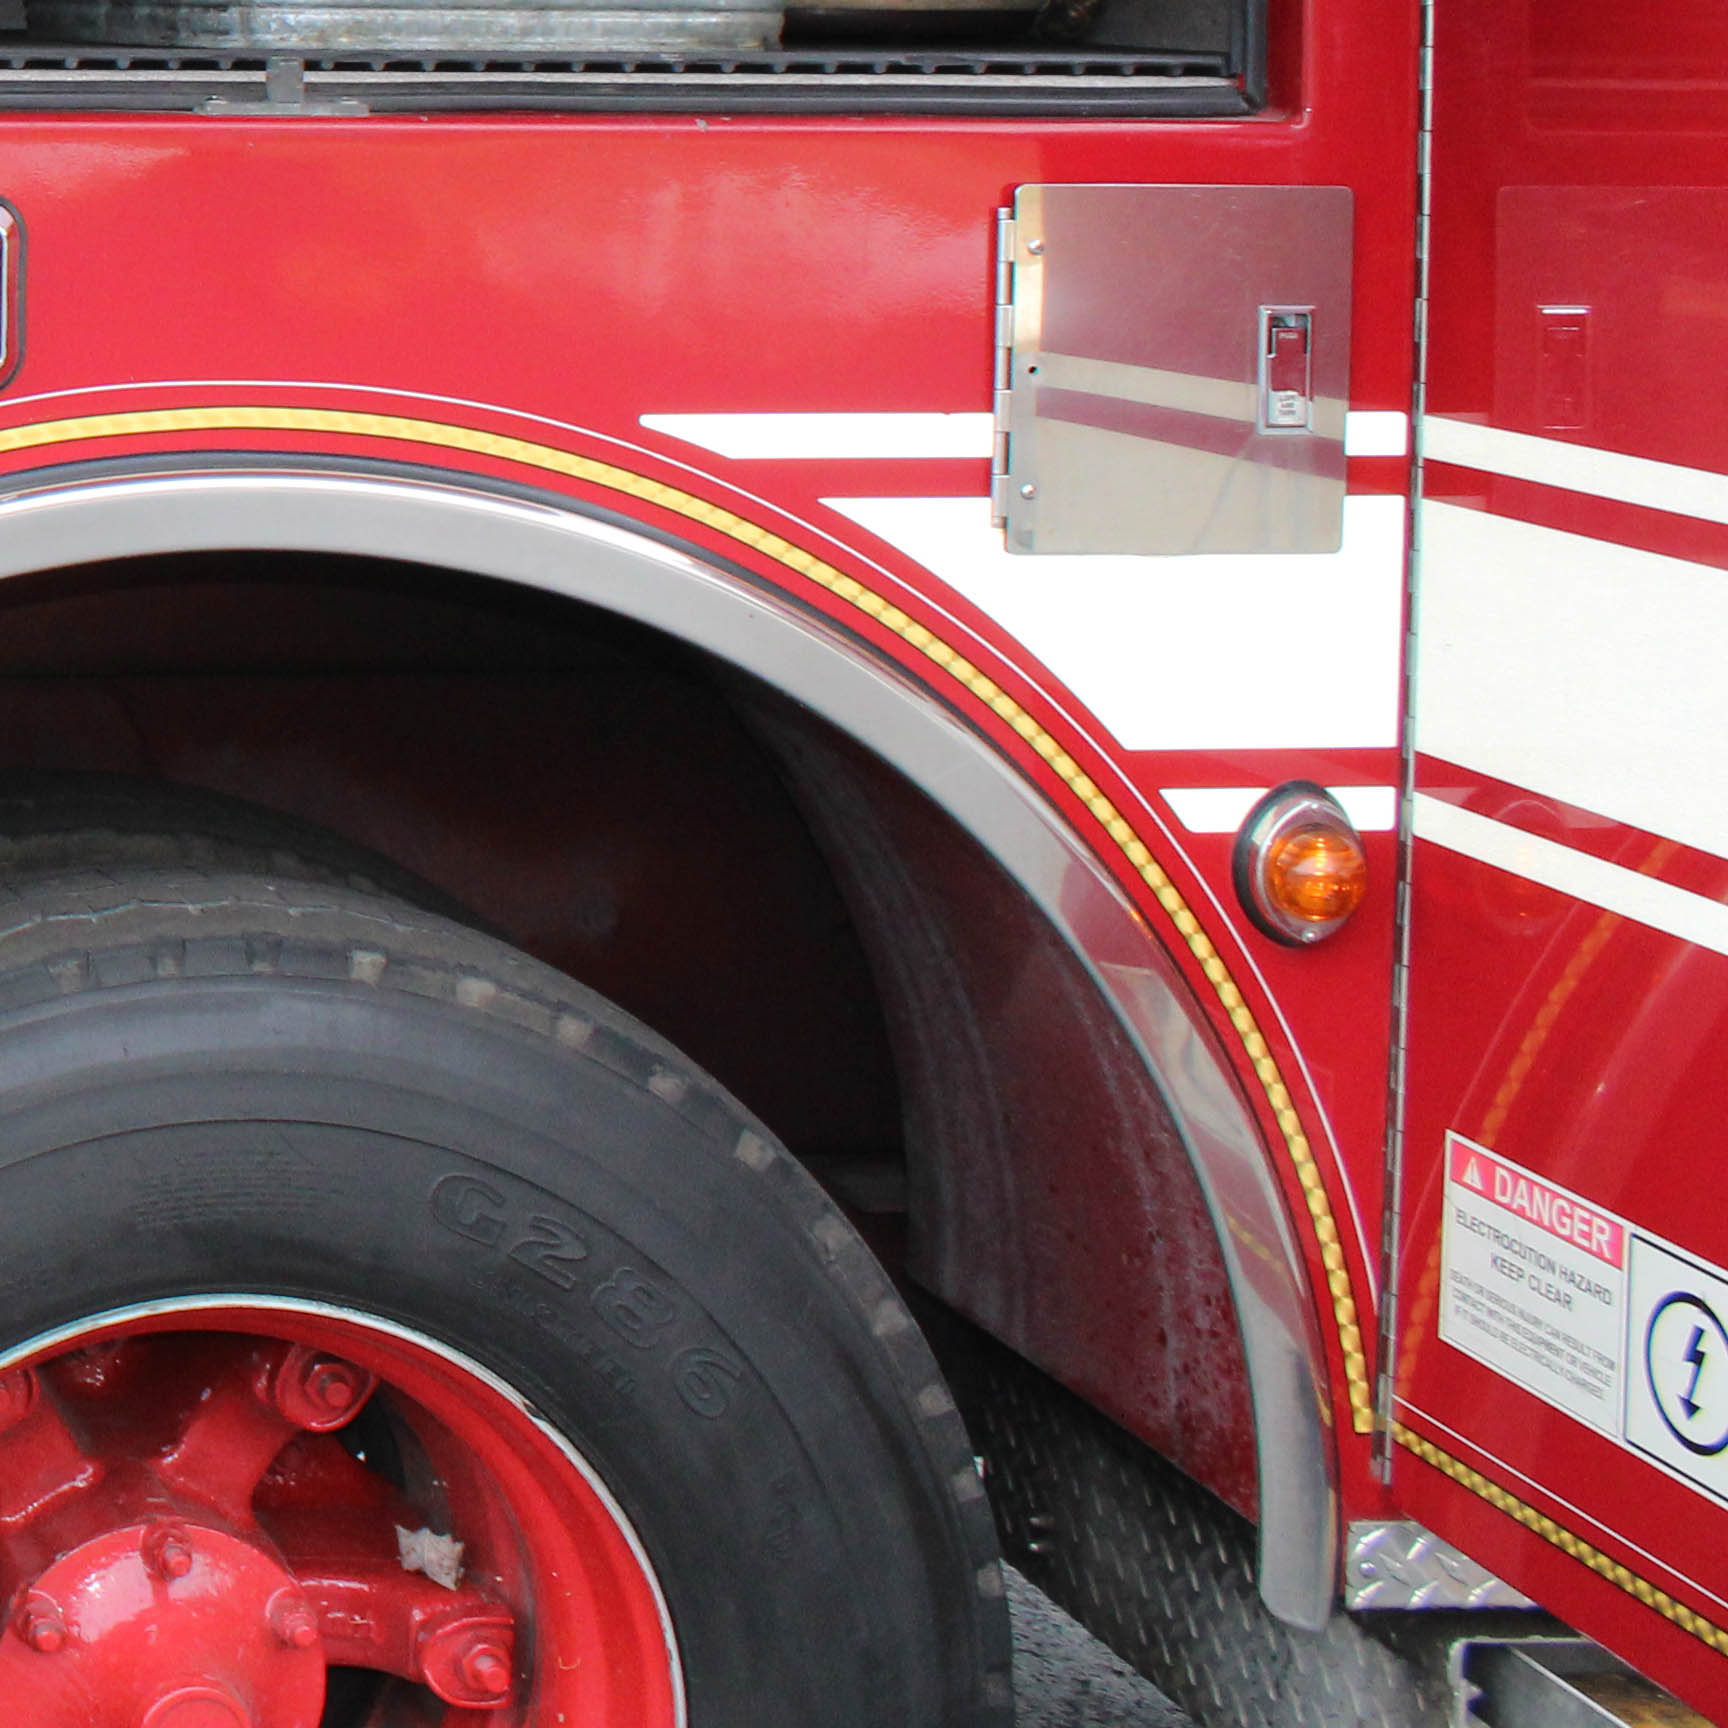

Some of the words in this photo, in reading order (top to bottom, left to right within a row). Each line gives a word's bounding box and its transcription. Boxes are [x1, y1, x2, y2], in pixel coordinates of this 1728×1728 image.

[1455, 1206, 1555, 1276] ELECTROCUTION
[1558, 1262, 1611, 1307] HAZARD
[1493, 1164, 1611, 1259] DANGER
[431, 1174, 742, 1419] G286
[1490, 1251, 1524, 1286] KEEP
[1527, 1271, 1572, 1313] CLEAR
